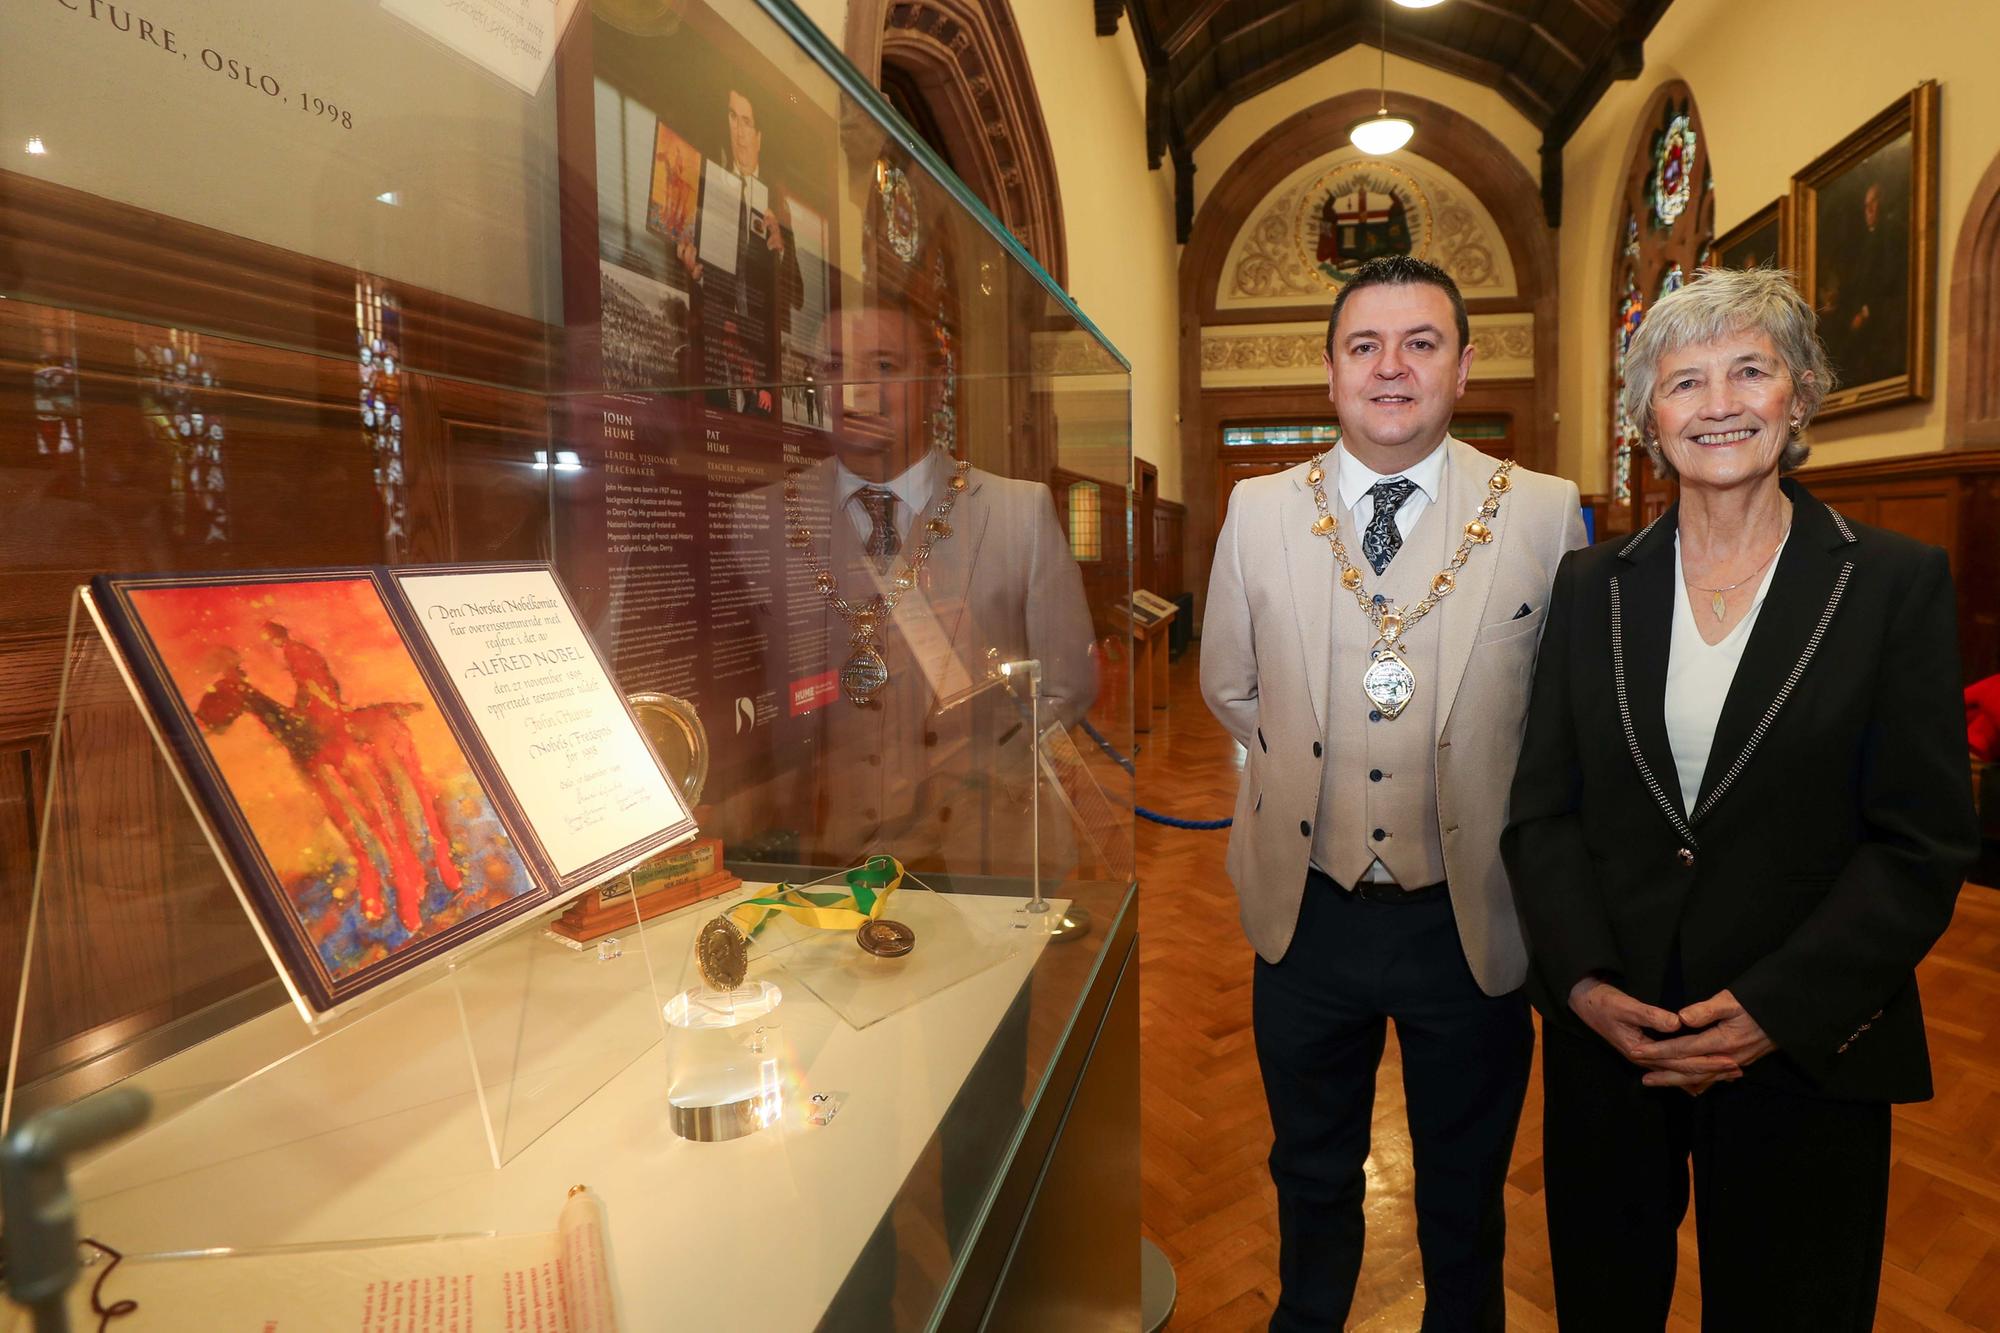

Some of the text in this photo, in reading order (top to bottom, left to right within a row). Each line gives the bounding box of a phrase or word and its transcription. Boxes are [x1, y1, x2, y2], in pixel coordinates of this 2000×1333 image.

[201, 48, 288, 104] OSLO,
[300, 93, 353, 130] 1998
[603, 411, 633, 426] JOHN
[604, 426, 635, 441] HUME
[706, 429, 720, 440] PAT
[706, 441, 730, 454] HUME
[783, 443, 800, 454] HUME
[605, 464, 656, 477] PEACEMAKER
[605, 482, 617, 492] John
[618, 484, 632, 492] Hume
[612, 508, 627, 518] Derry
[628, 521, 651, 530] University
[428, 604, 461, 621] Den
[459, 599, 502, 617] Norske
[449, 622, 467, 636] har
[464, 646, 585, 679] ALFRED NOBEL
[794, 686, 815, 702] HUME
[812, 1094, 829, 1102] 2
